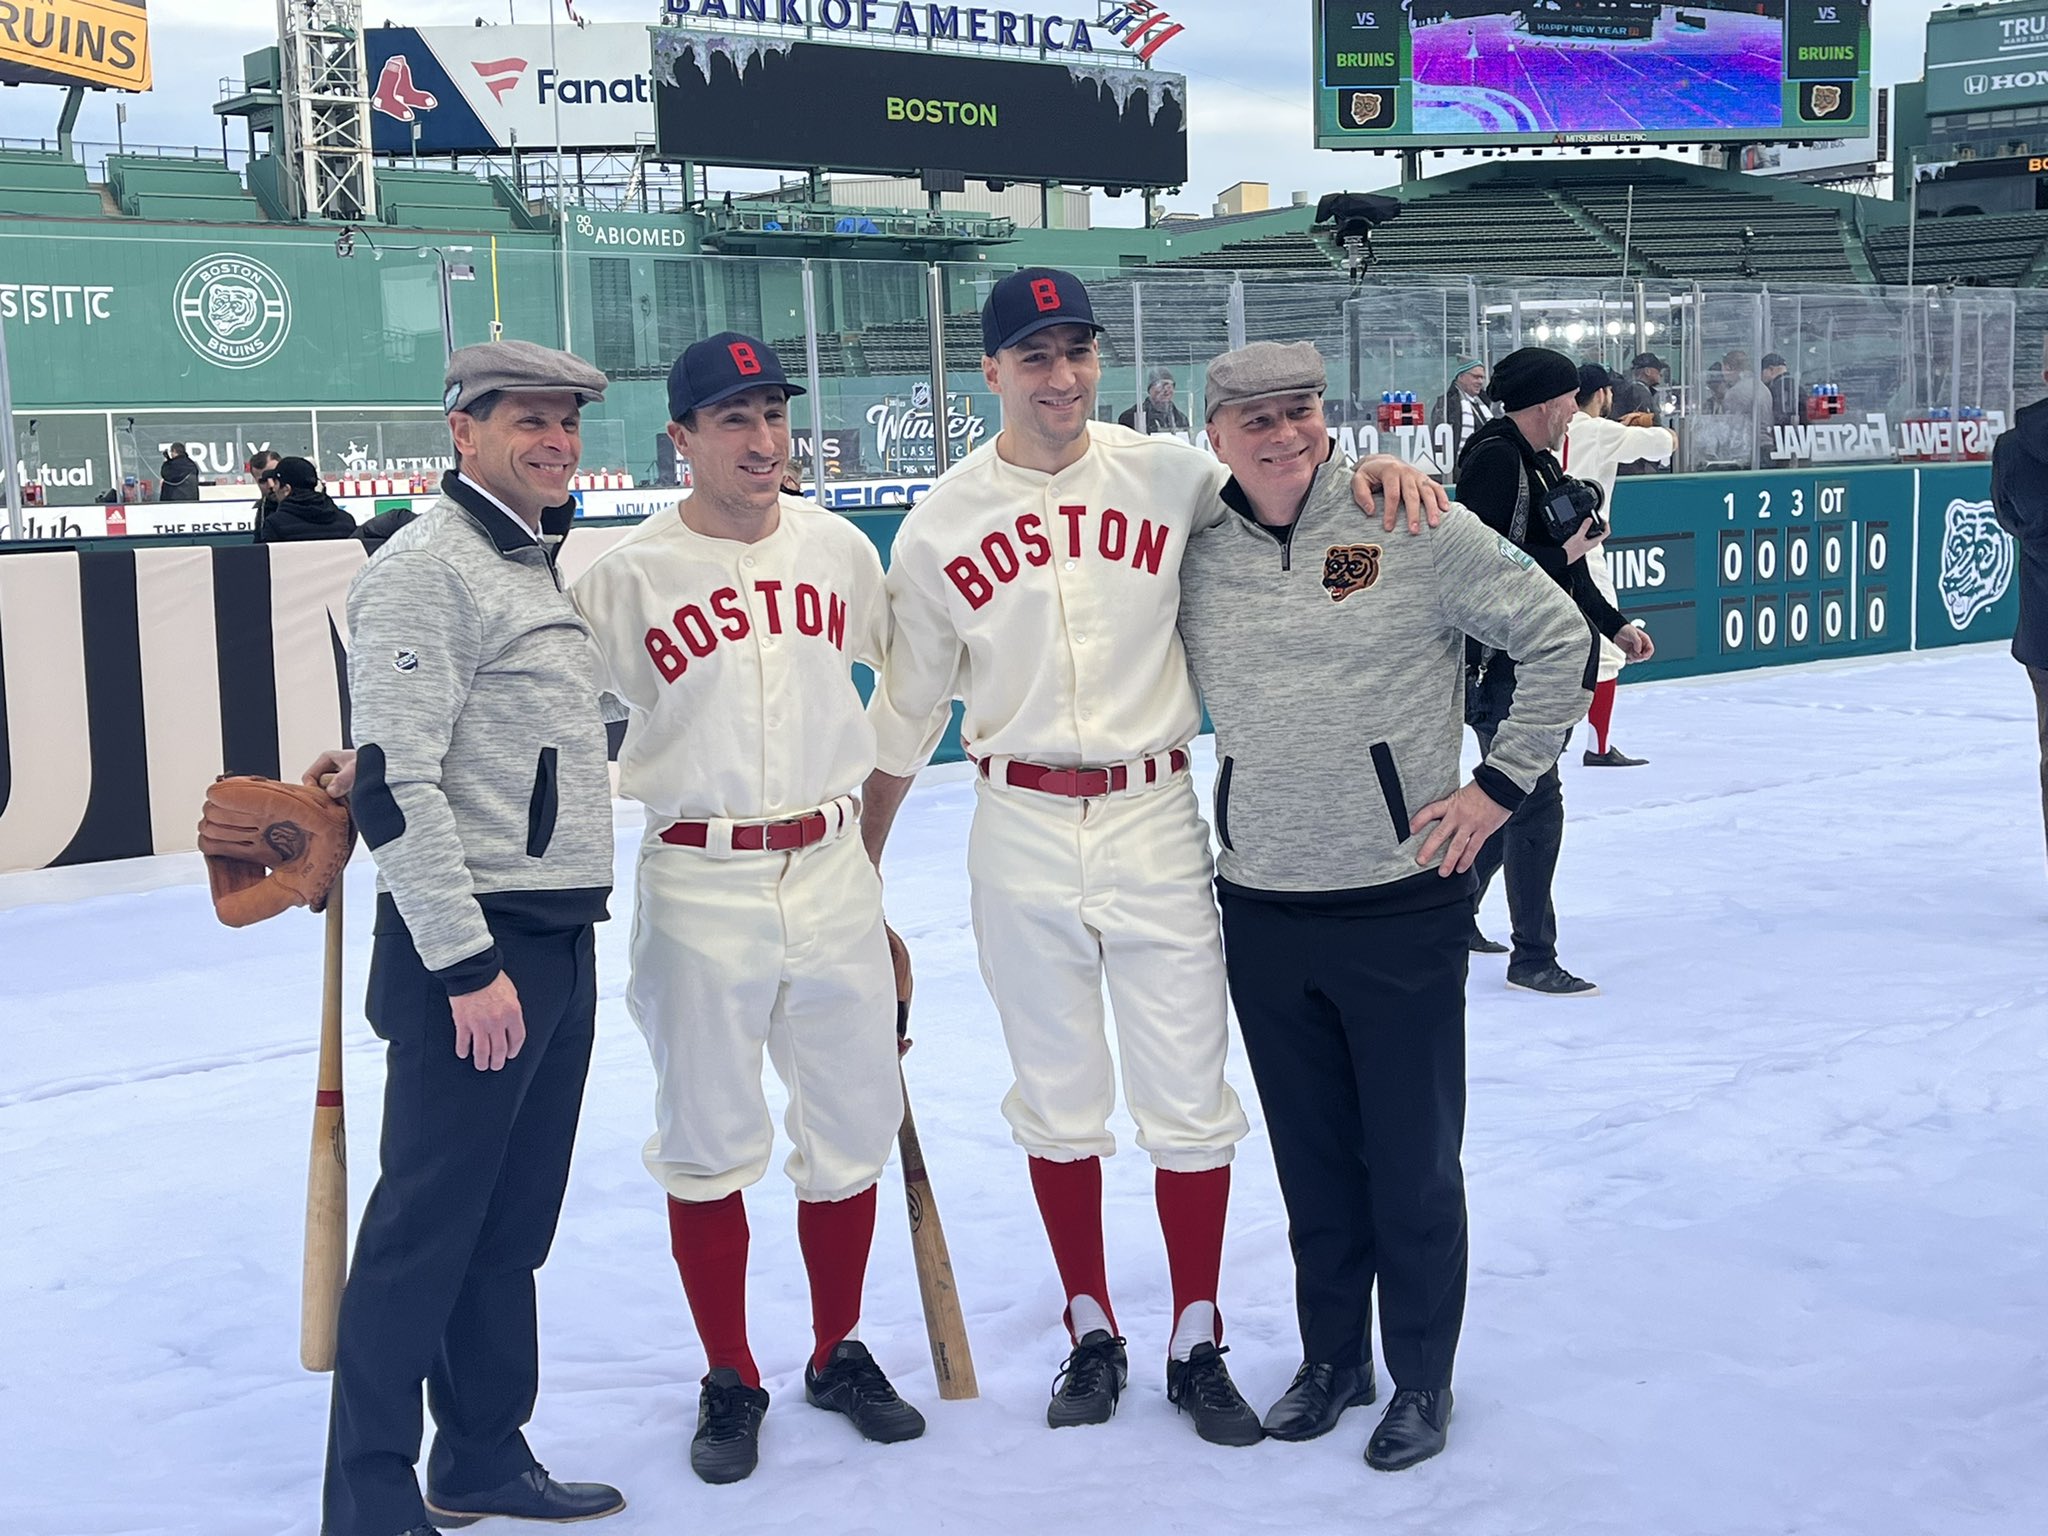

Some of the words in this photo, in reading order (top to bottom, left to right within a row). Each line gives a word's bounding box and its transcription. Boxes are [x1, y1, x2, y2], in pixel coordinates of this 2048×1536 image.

[1356, 12, 1375, 26] VS
[1818, 7, 1837, 20] VS
[819, 0, 877, 31] OF
[893, 1, 1093, 52] AMERICA
[1537, 23, 1568, 32] HAPPY
[1571, 25, 1595, 33] NEW
[1597, 26, 1627, 35] YEAR
[1999, 16, 2046, 37] TRU
[1337, 53, 1395, 67] BRUINS
[1798, 46, 1854, 60] BRUINS
[887, 97, 998, 127] BOSTON
[1566, 133, 1609, 143] MITSUBISHI
[1610, 133, 1647, 143] ELECTRIC
[594, 226, 686, 247] ABIOMED
[199, 264, 262, 283] BOSTON
[1030, 278, 1061, 312] B
[207, 337, 265, 357] BRUINS
[727, 342, 762, 375] B
[890, 445, 964, 457] CLASSC
[1724, 492, 1735, 520] 1
[1758, 490, 1771, 518] 2
[1791, 489, 1804, 517] 3
[1820, 487, 1845, 514] OT
[153, 524, 186, 534] THE
[192, 522, 233, 532] BEST
[942, 505, 1170, 611] BOSTON
[1724, 542, 1743, 581] 0
[1758, 540, 1776, 579] 0
[1791, 538, 1808, 577] 0
[1825, 537, 1841, 573] 0
[1869, 533, 1887, 570] 0
[644, 580, 846, 685] BOSTON
[1725, 609, 1744, 648] 0
[1758, 606, 1776, 645] 0
[1791, 604, 1808, 642] 0
[1826, 601, 1842, 637] 0
[1869, 597, 1886, 633] 0
